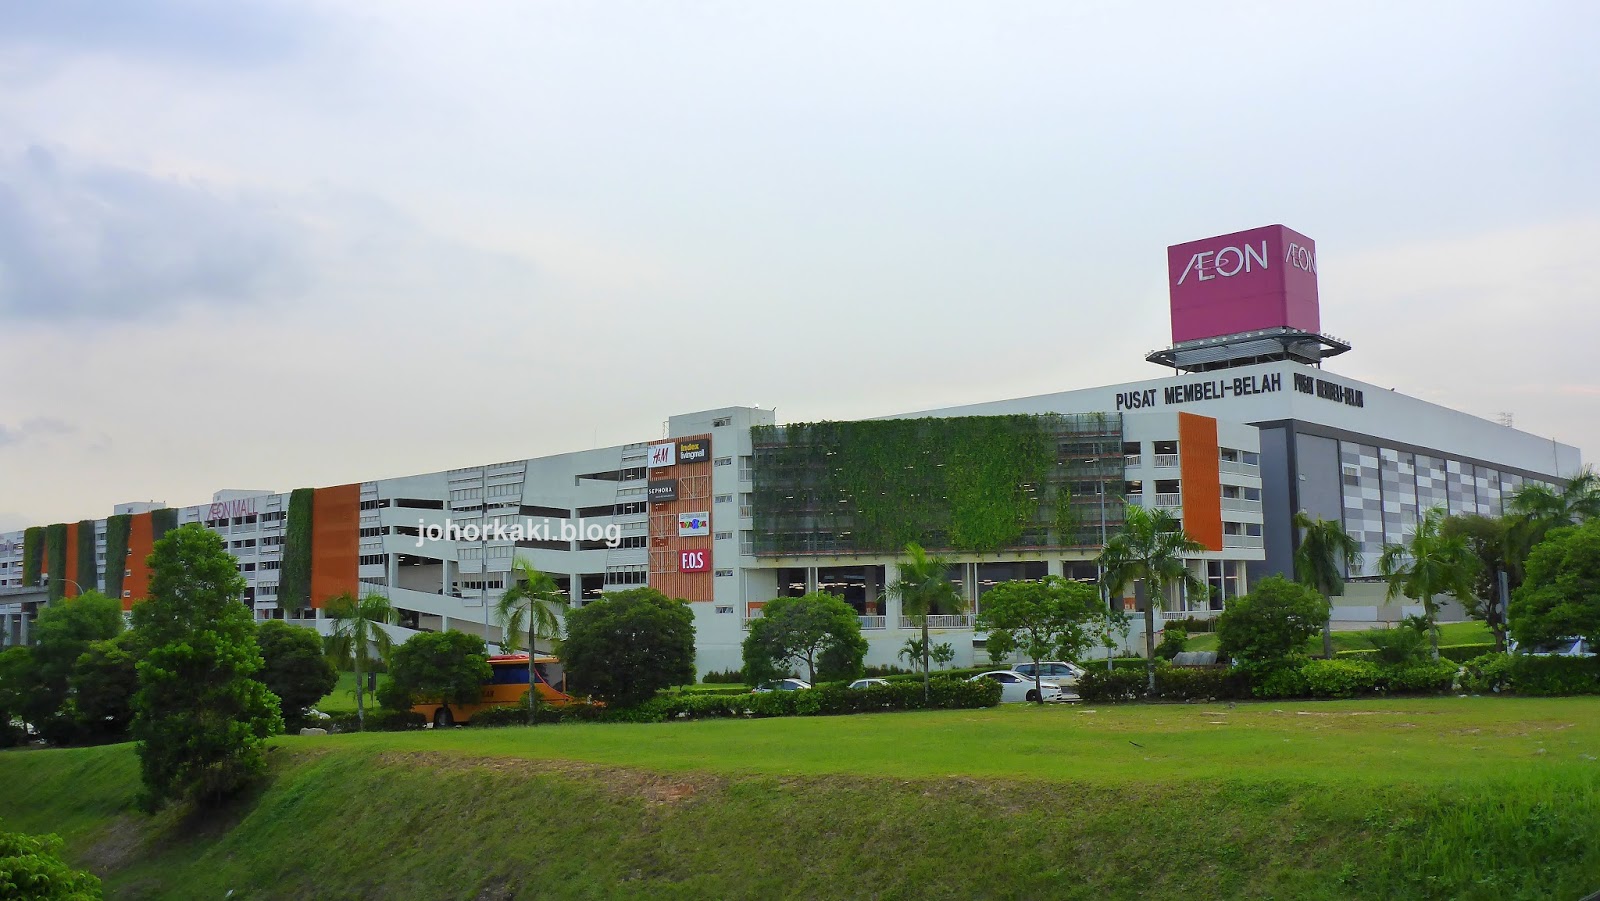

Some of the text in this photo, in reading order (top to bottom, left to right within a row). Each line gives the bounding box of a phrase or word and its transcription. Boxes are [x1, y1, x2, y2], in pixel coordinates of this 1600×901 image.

[1116, 373, 1282, 411] PUSAT MEMBELI-BELAH
[1294, 373, 1314, 395] PUSAT
[649, 487, 672, 495] SEPHORA
[233, 498, 258, 517] MALL
